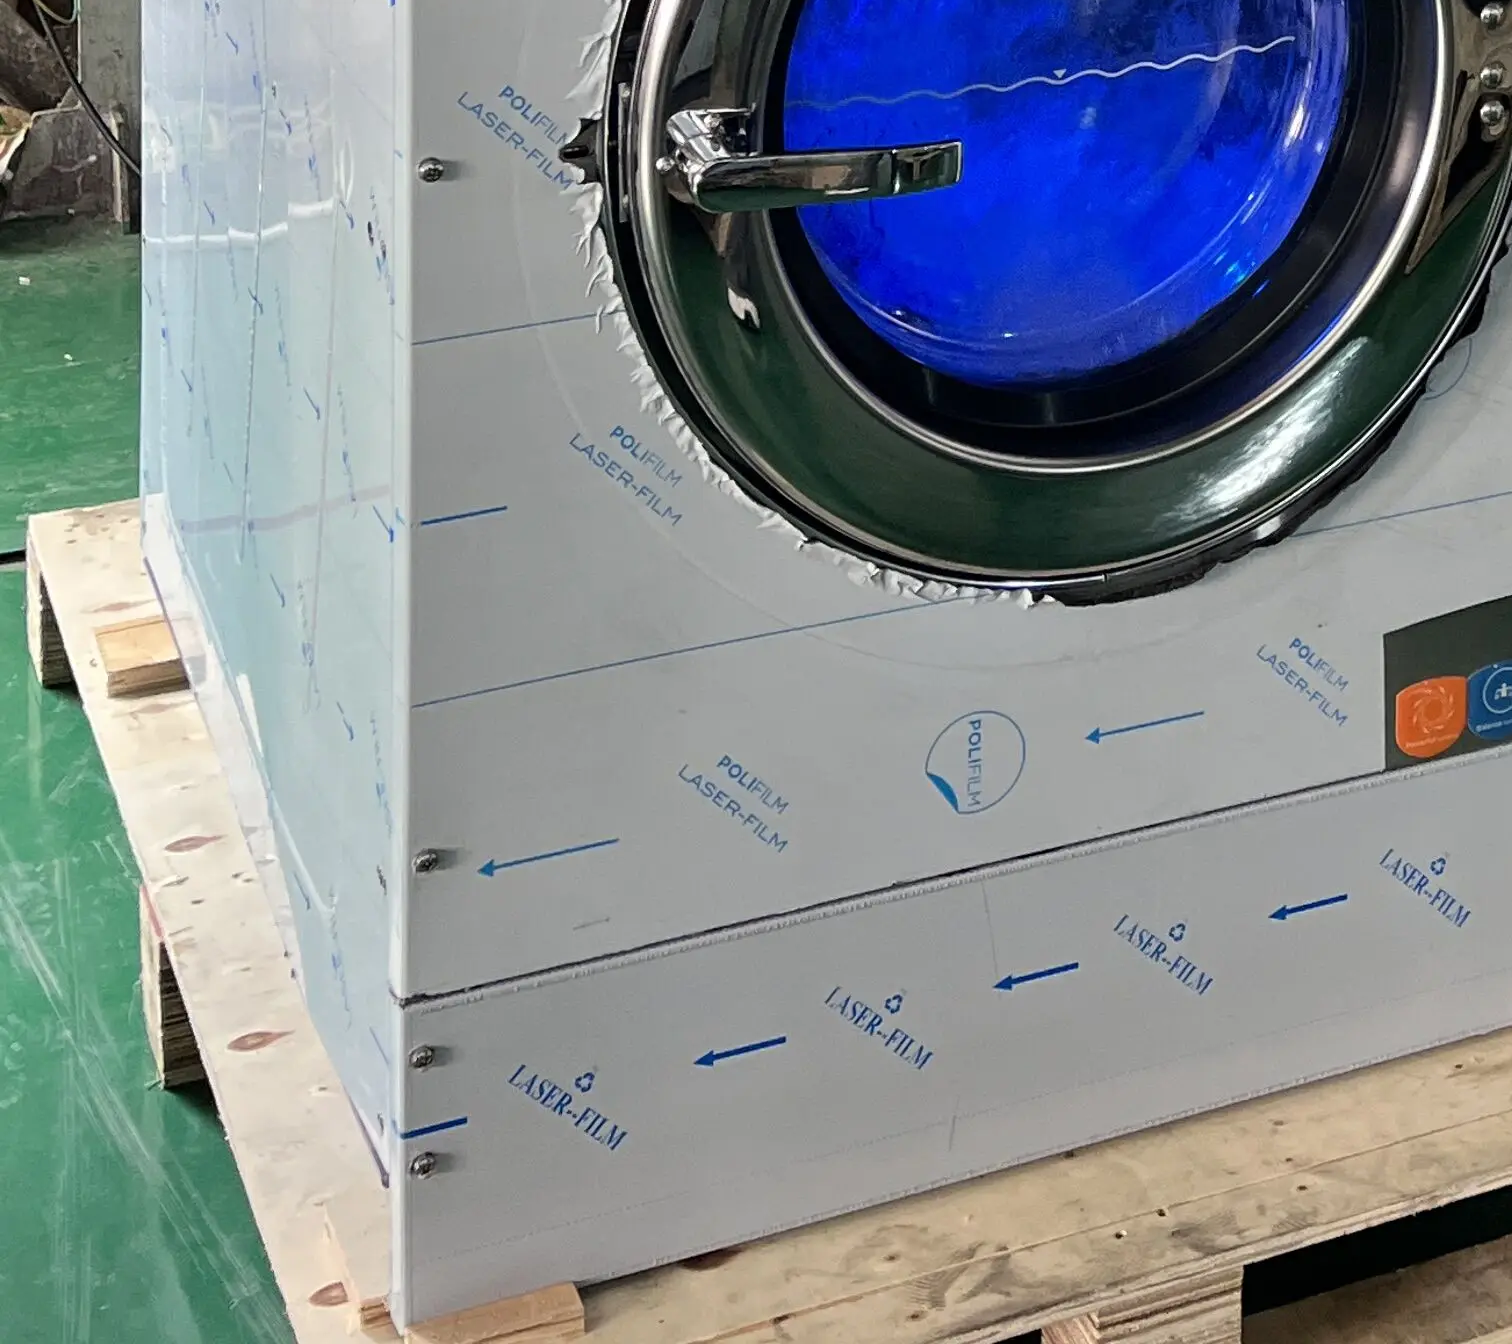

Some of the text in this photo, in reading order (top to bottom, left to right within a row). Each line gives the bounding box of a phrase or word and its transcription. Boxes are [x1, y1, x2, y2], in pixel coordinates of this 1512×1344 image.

[456, 91, 576, 190] LASER-FILM
[568, 432, 683, 527] LASER-FILM
[609, 425, 684, 489] POLIFILM
[1256, 643, 1349, 727] LASER-FILM
[1288, 637, 1350, 693] POLIFILM
[715, 753, 790, 816] POLIFILM
[966, 718, 983, 808] POLIFILM
[677, 763, 789, 855] LASER-FILM
